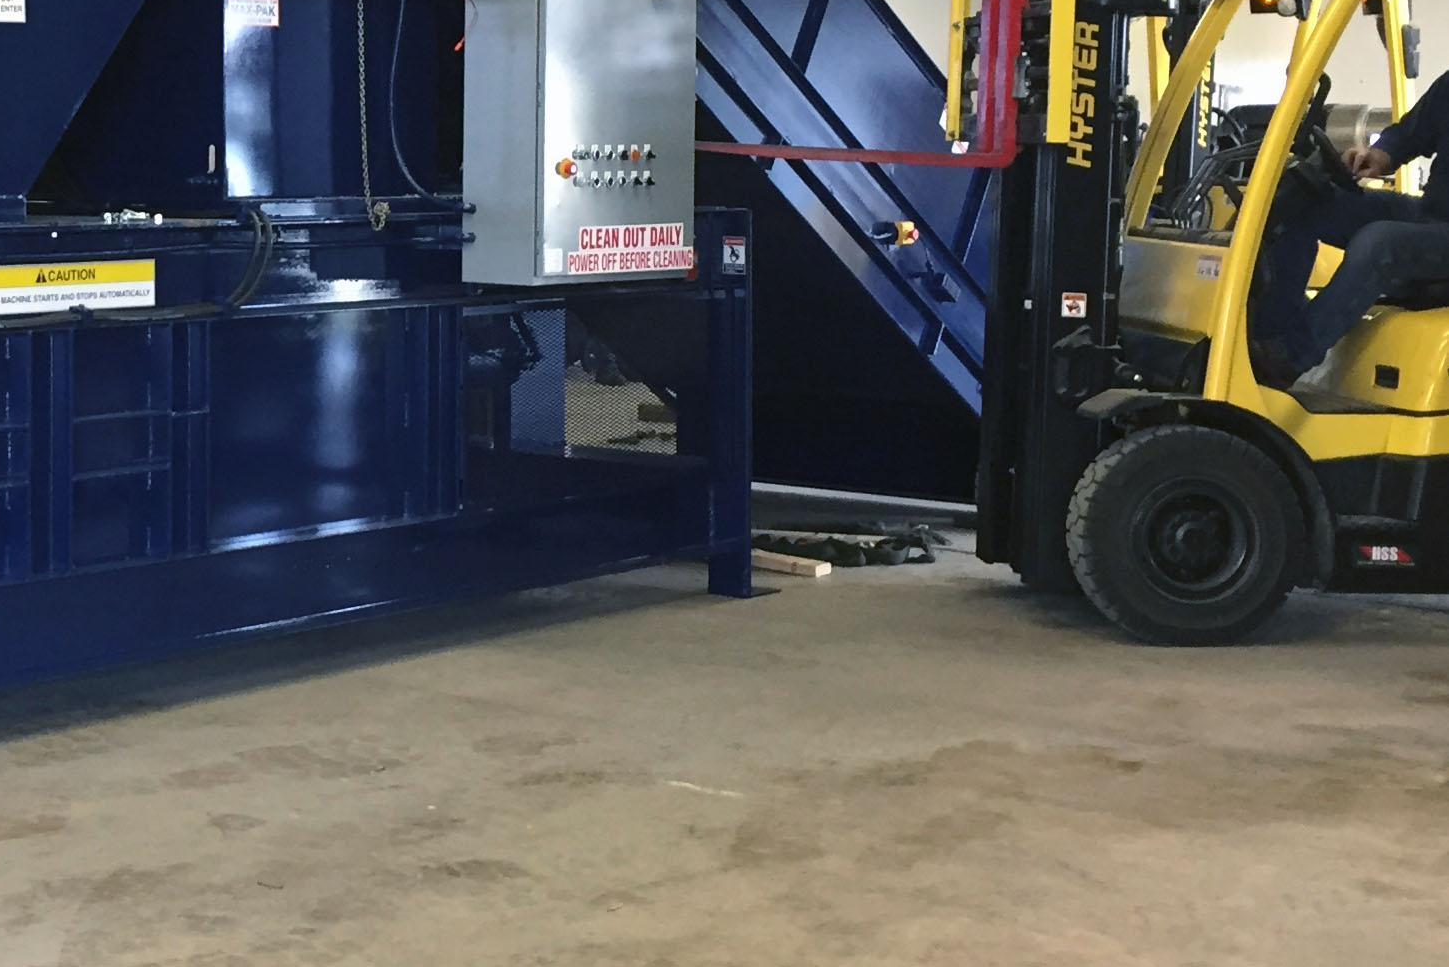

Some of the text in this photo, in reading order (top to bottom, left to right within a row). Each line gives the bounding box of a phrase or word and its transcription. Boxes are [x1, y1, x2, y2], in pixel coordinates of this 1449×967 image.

[1, 5, 23, 13] ENTER
[1066, 20, 1100, 168] HYSTER
[1198, 60, 1211, 147] HYSTE
[581, 225, 682, 250] CLEAN OUT DAILY
[569, 249, 692, 272] POWER OFF BEFORE CLEANING
[48, 269, 95, 282] CAUTION
[1, 295, 31, 304] MACHINE
[33, 294, 59, 303] STARTS
[61, 293, 75, 301] AND
[76, 292, 97, 300] STOPS
[99, 288, 150, 299] AUTOMATICALLY
